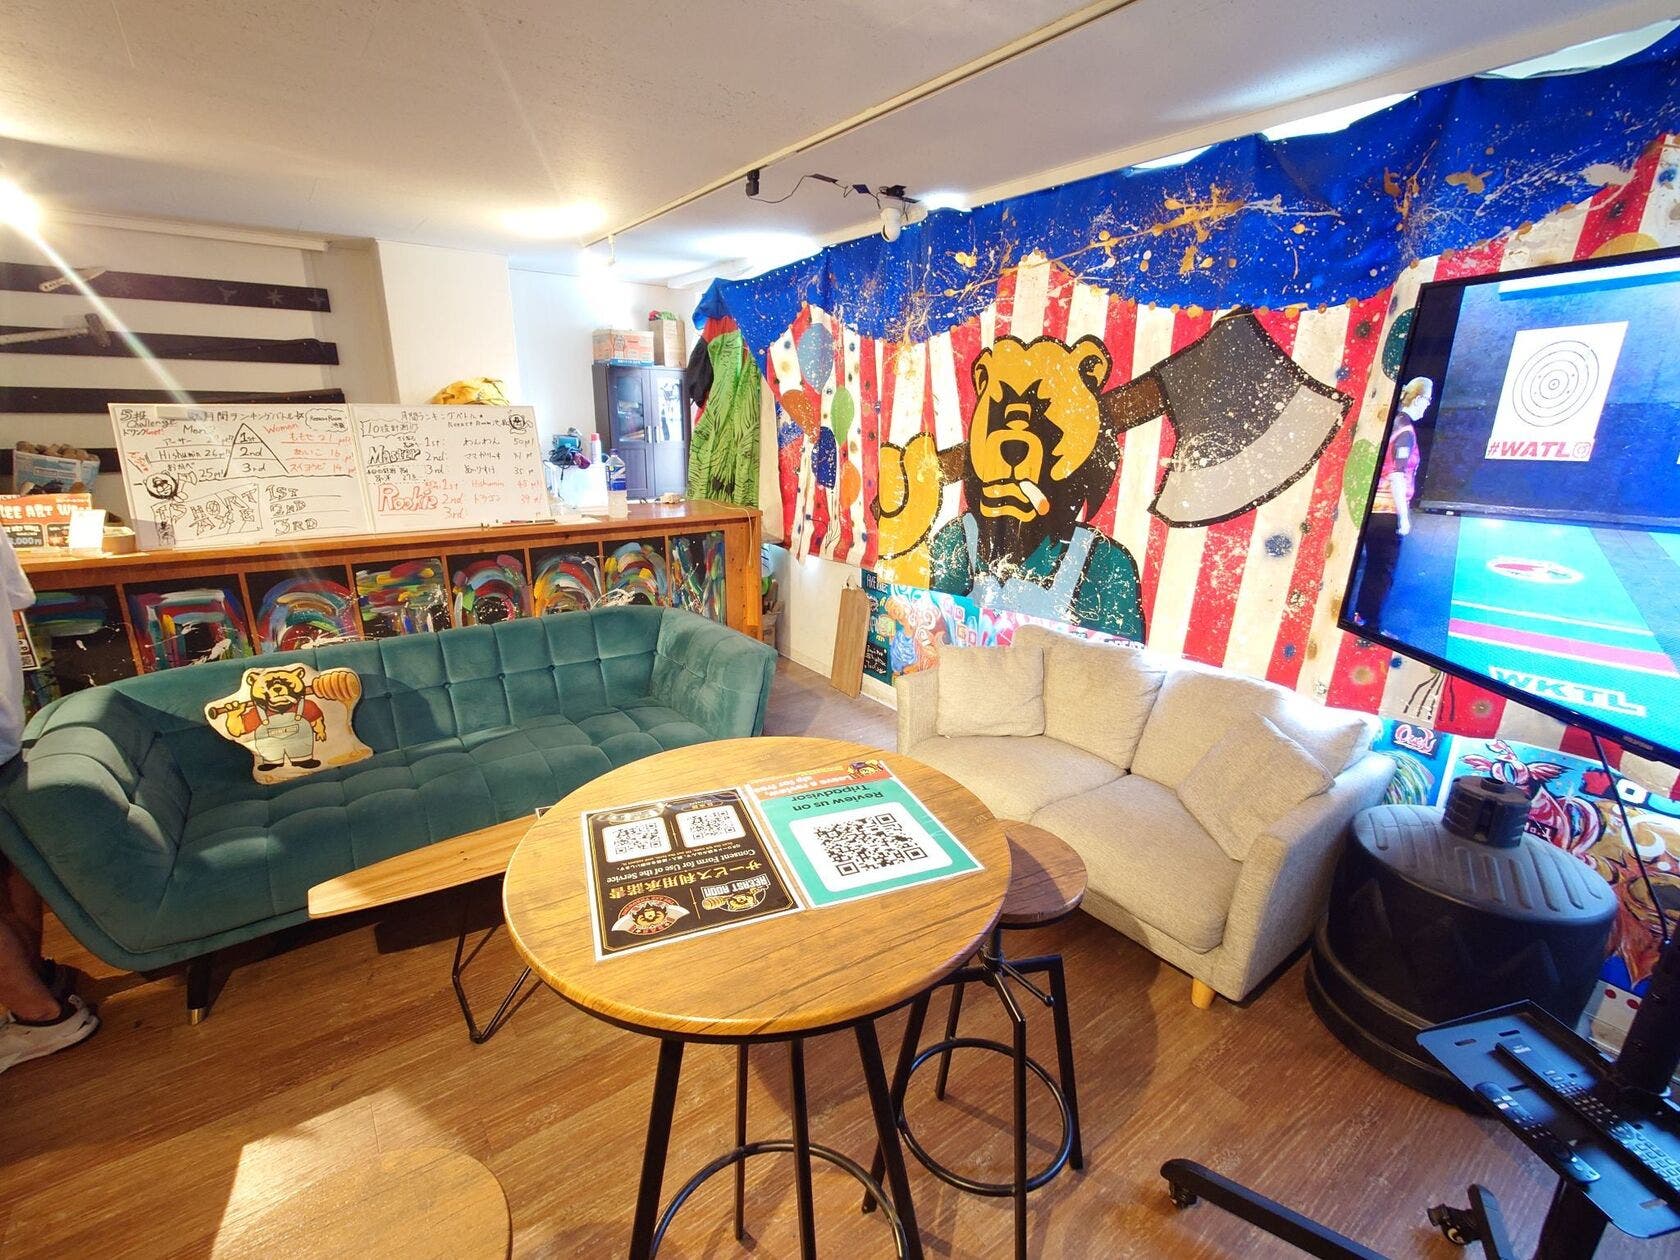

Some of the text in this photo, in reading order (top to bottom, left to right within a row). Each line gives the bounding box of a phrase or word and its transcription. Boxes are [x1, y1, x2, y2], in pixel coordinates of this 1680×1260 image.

[239, 446, 263, 457] 2nd
[1488, 441, 1571, 458] #WATL
[242, 462, 266, 473] 3rd
[790, 784, 871, 802] Tripadvisor
[792, 791, 885, 812] Review us on
[696, 855, 719, 866] Form
[720, 849, 756, 862] Consent
[664, 864, 681, 874] Use
[682, 861, 695, 869] for
[607, 872, 638, 884] Service
[608, 860, 762, 899] サービス利用承諾書
[639, 870, 653, 879] the
